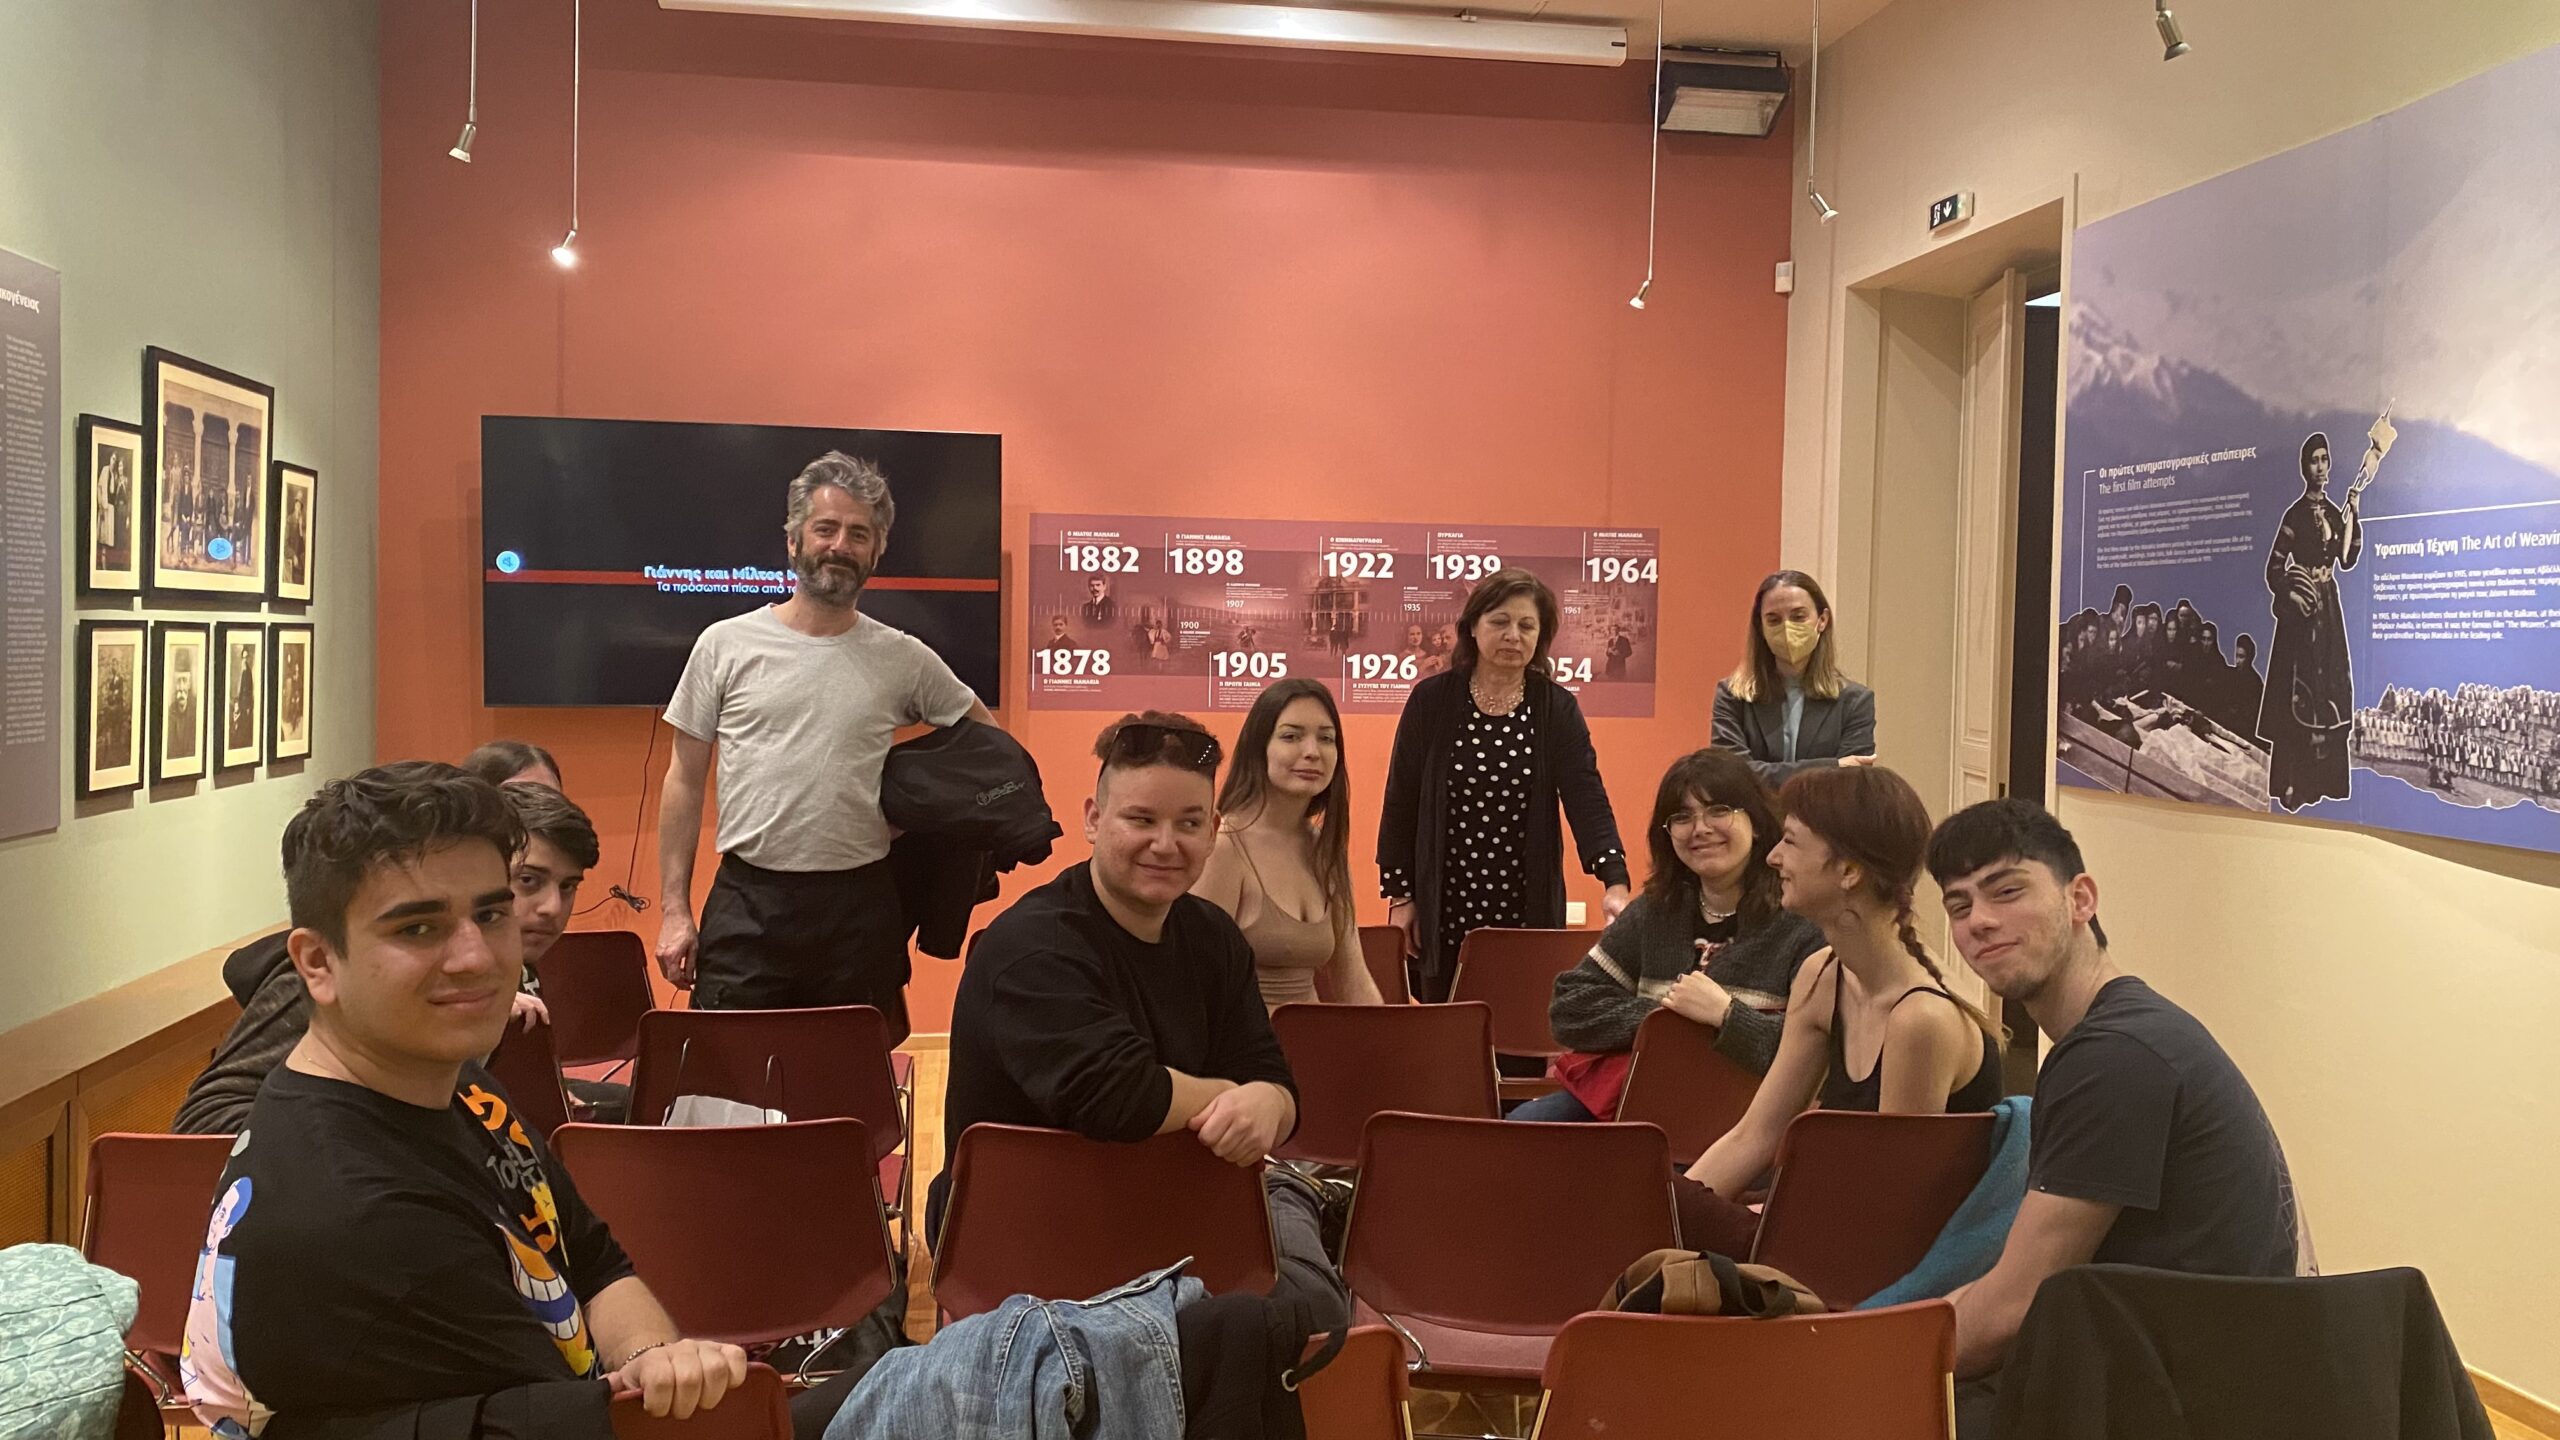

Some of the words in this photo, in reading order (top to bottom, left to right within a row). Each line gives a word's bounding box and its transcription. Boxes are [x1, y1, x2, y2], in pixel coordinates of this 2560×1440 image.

[0, 287, 40, 313] ικογένειας
[2108, 464, 2135, 479] πρώτες
[2135, 452, 2209, 474] κινηματογραφικές
[2211, 447, 2257, 462] απόπειρες
[2099, 483, 2111, 495] The
[2112, 480, 2126, 493] first
[2127, 479, 2141, 491] film
[2143, 474, 2176, 489] attempts
[2375, 538, 2424, 559] Υφαντική
[2426, 538, 2458, 556] Τέχνη
[2462, 535, 2481, 551] The
[2483, 534, 2501, 550] Art
[2504, 531, 2517, 549] of
[2519, 529, 2560, 547] Weavin
[1064, 545, 1139, 573] 1882
[1169, 548, 1244, 575] 1898
[1323, 552, 1394, 579] 1922
[1430, 554, 1502, 581] 1939
[1586, 557, 1658, 584] 1964
[644, 565, 701, 582] Γιάννης
[705, 570, 729, 580] και
[733, 566, 784, 583] Μίλτος
[657, 581, 670, 592] Τα
[673, 582, 728, 594] πρόσωπα
[731, 582, 759, 593] πίσω
[762, 583, 785, 594] από
[1226, 600, 1244, 608] 1907
[1403, 603, 1421, 612] 1935
[1180, 621, 1200, 630] 1900
[1036, 649, 1111, 676] 1878
[1213, 652, 1287, 678] 1905
[1347, 654, 1418, 680] 1926
[1547, 656, 1592, 683] 54
